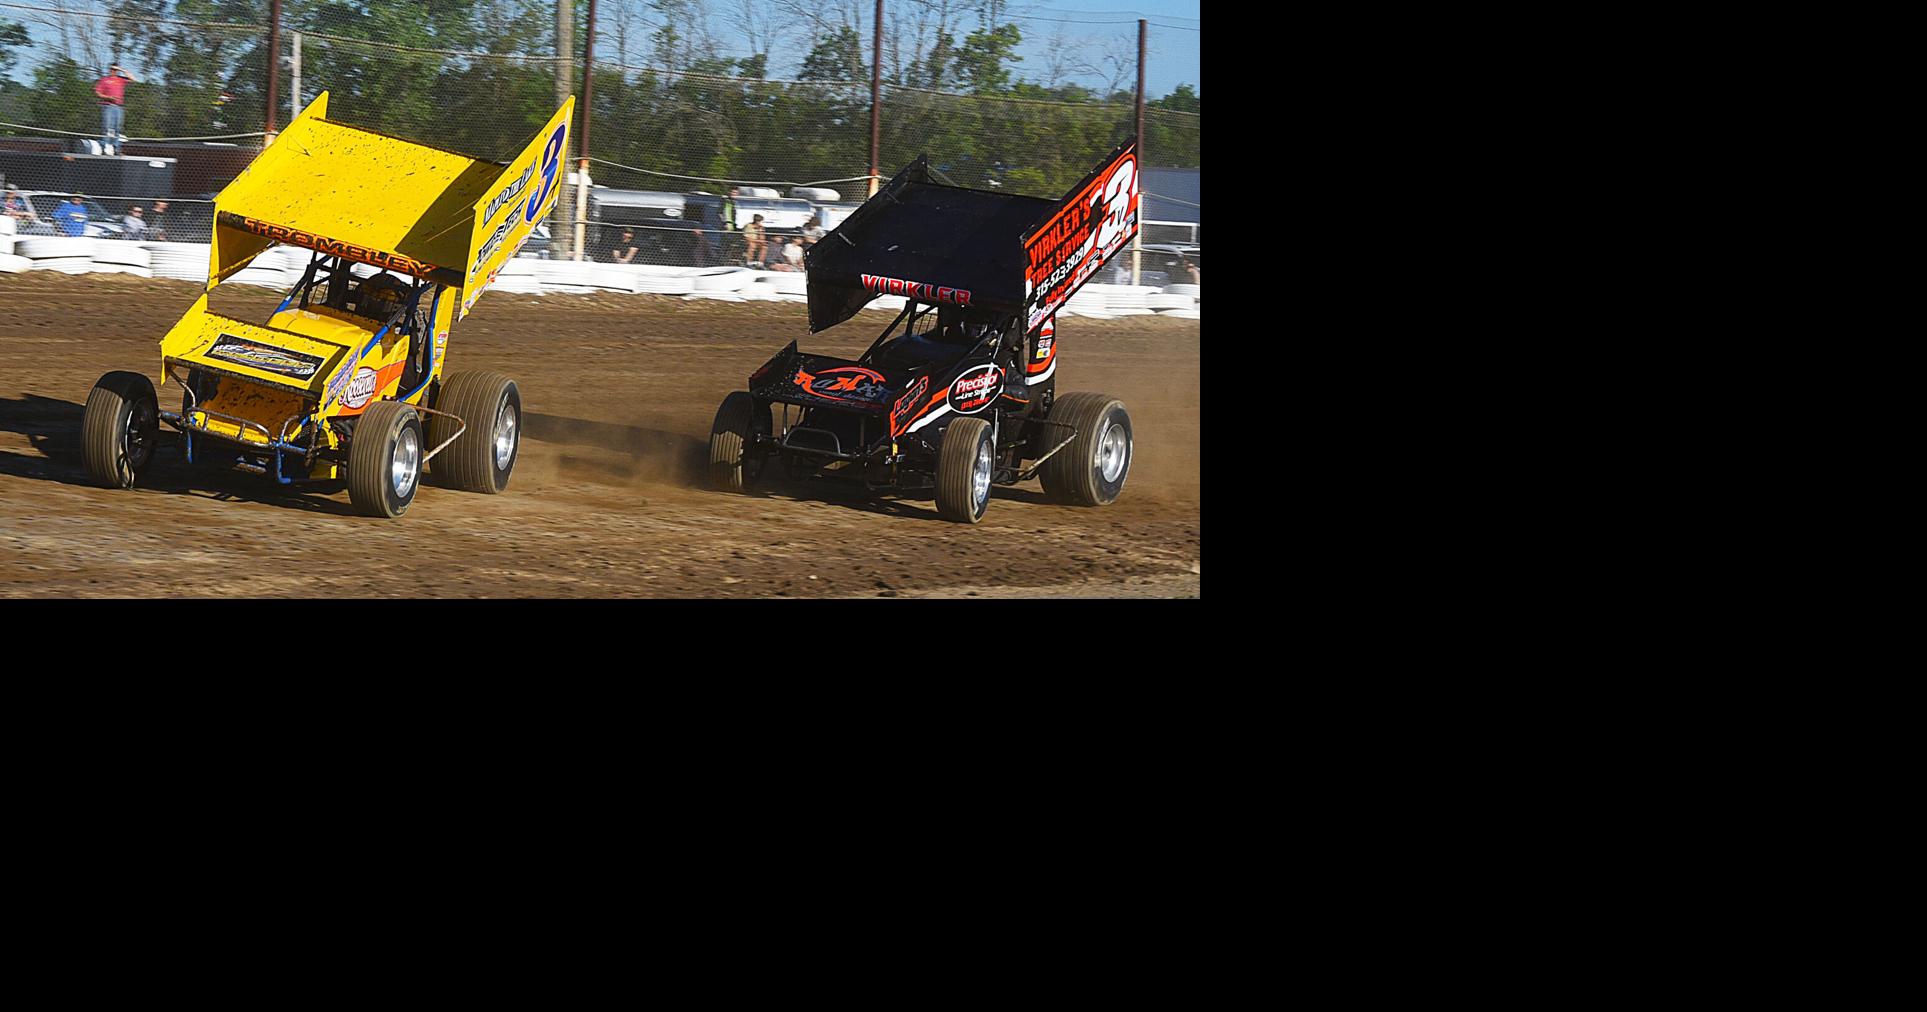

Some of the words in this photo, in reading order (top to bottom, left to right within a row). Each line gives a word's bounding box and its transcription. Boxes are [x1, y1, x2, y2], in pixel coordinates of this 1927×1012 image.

[525, 122, 566, 224] 3
[1029, 197, 1091, 268] VIRKLER'S
[1096, 157, 1135, 249] 3
[244, 217, 436, 276] TROMBLEY
[1031, 257, 1054, 289] TREE
[861, 273, 973, 306] VIRKLER
[955, 372, 998, 395] Preciso
